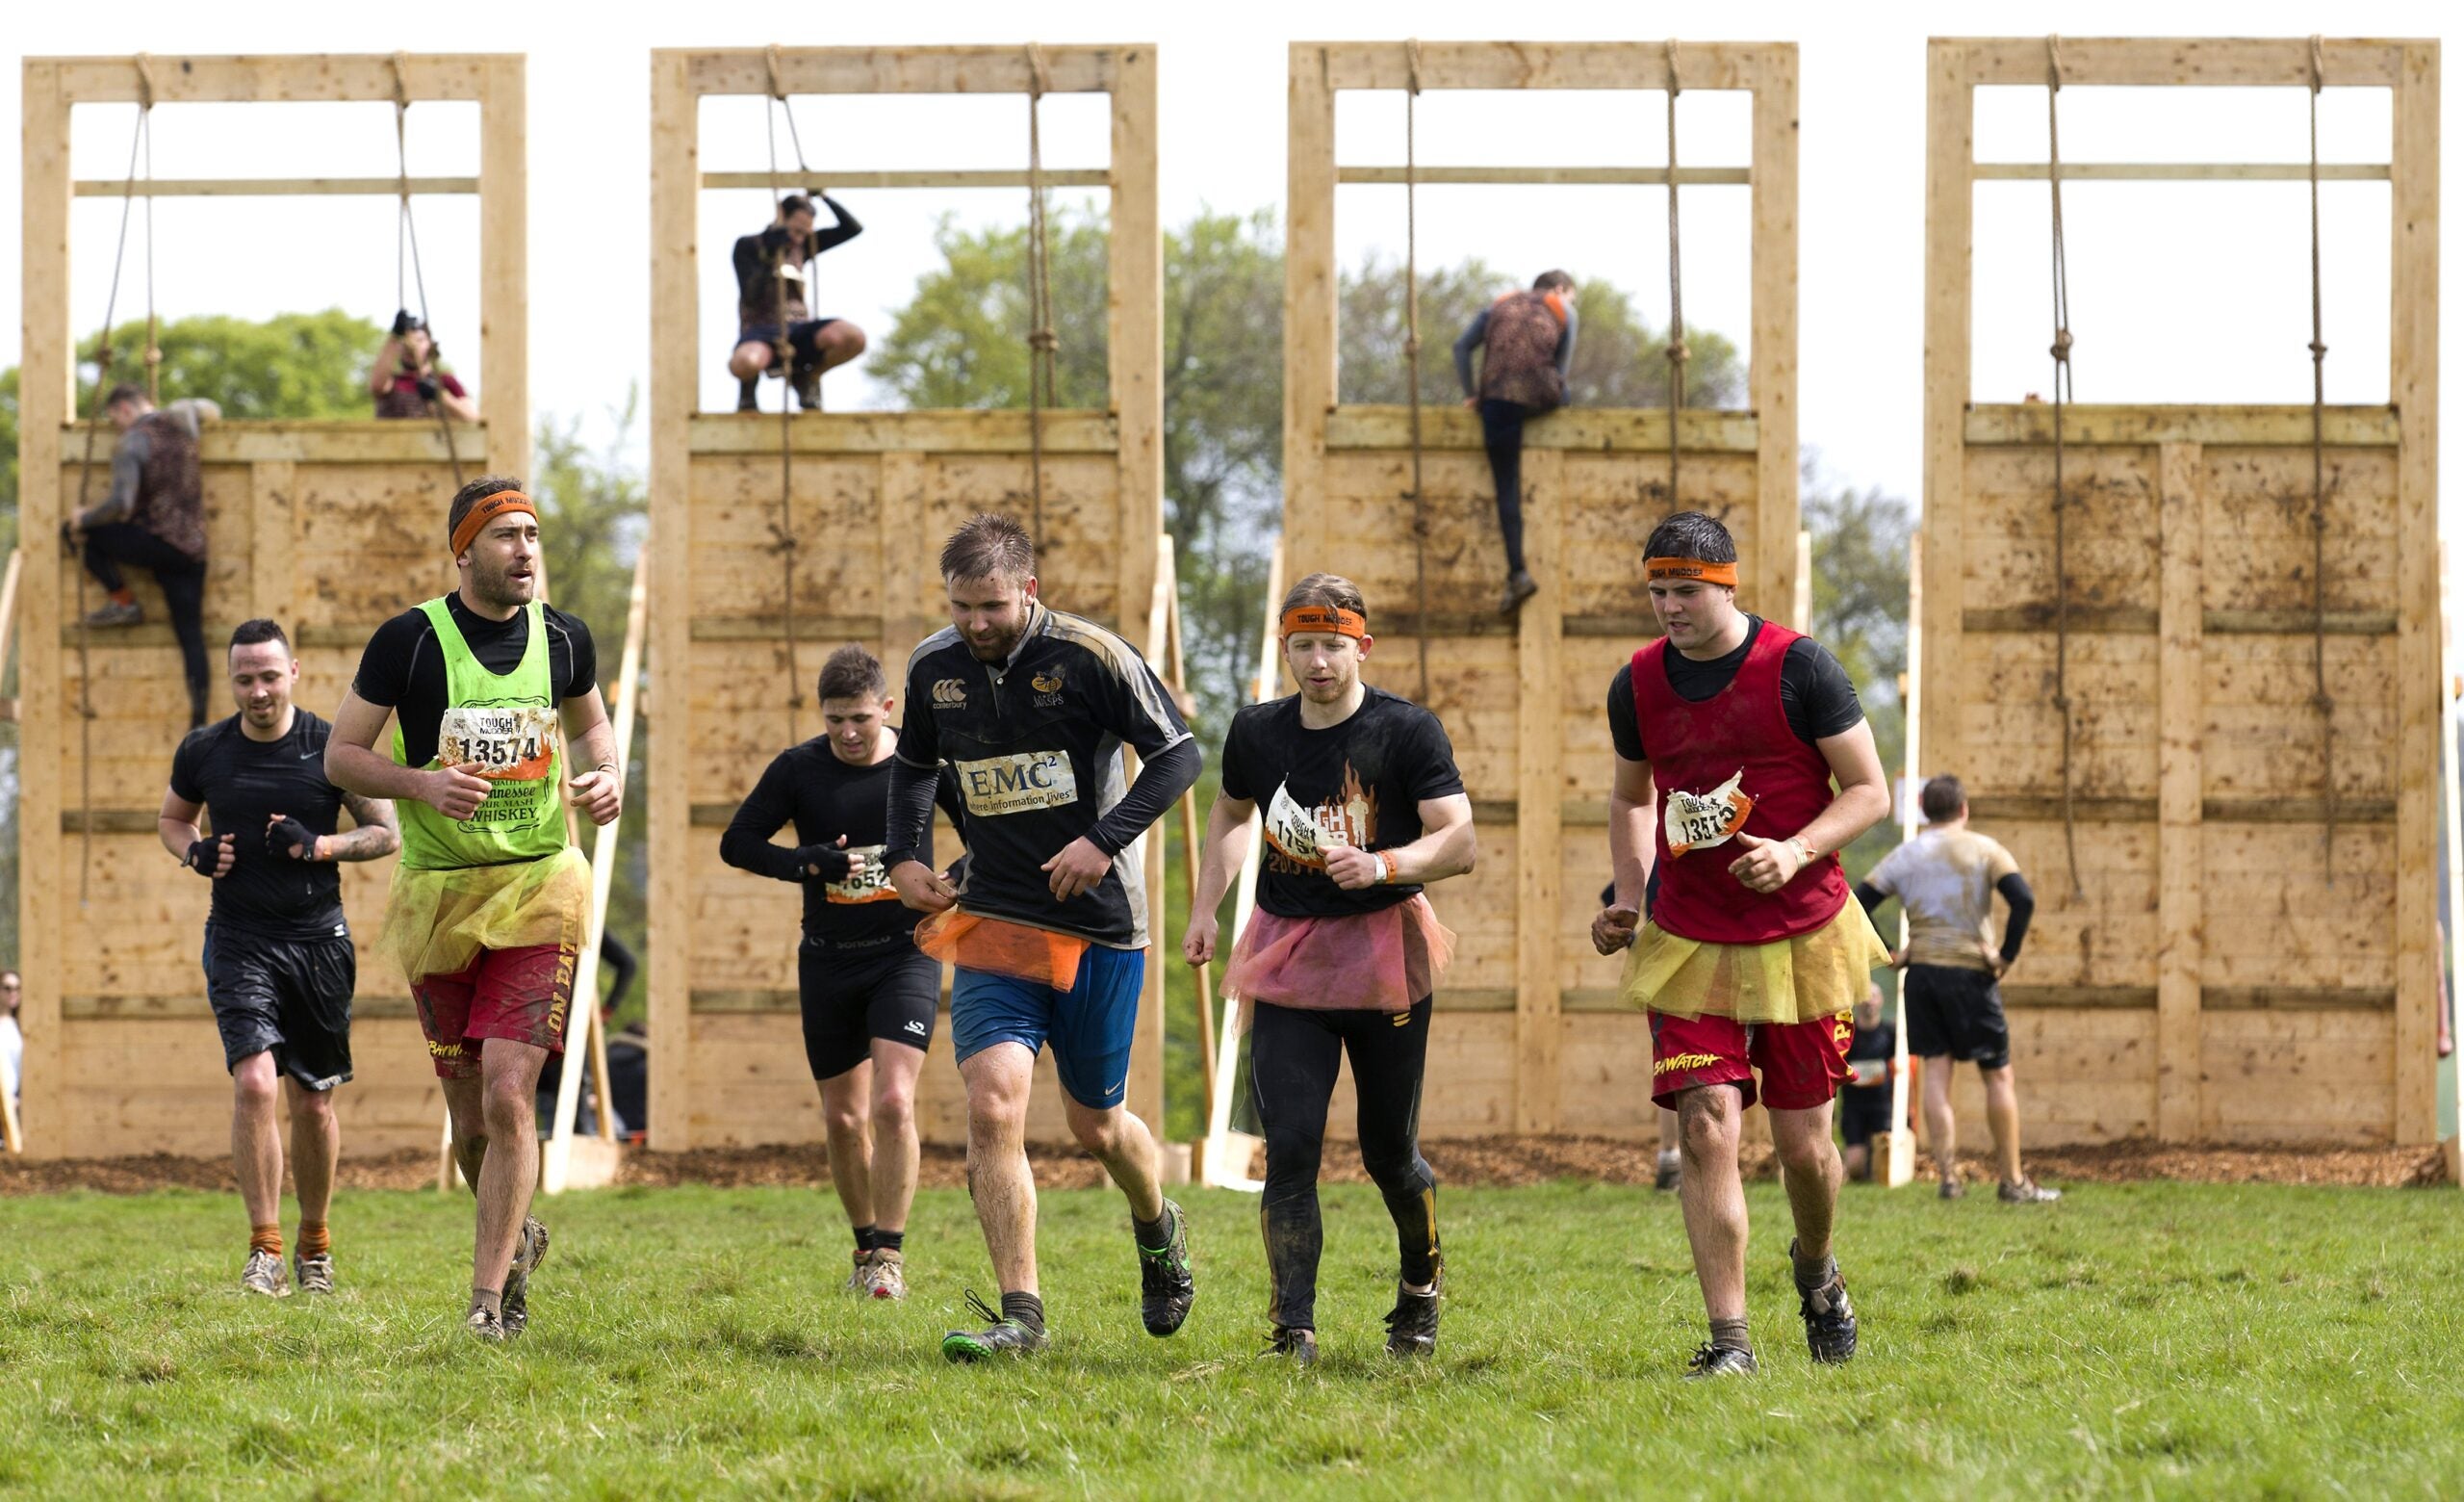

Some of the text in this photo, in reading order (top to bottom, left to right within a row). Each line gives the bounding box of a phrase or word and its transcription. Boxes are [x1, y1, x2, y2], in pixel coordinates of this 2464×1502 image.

[482, 497, 504, 514] TOUGH
[1296, 613, 1321, 625] TOUGH
[933, 701, 967, 711] canterbury
[480, 717, 513, 728] TOUGH
[459, 738, 537, 764] 13574
[486, 786, 537, 800] nnessee
[501, 798, 534, 808] MASH
[990, 793, 1045, 811] information
[1045, 790, 1070, 805] lives
[1681, 797, 1706, 809] TOU
[471, 807, 538, 822] WHISKEY
[842, 868, 887, 890] 652
[547, 991, 569, 1033] ON
